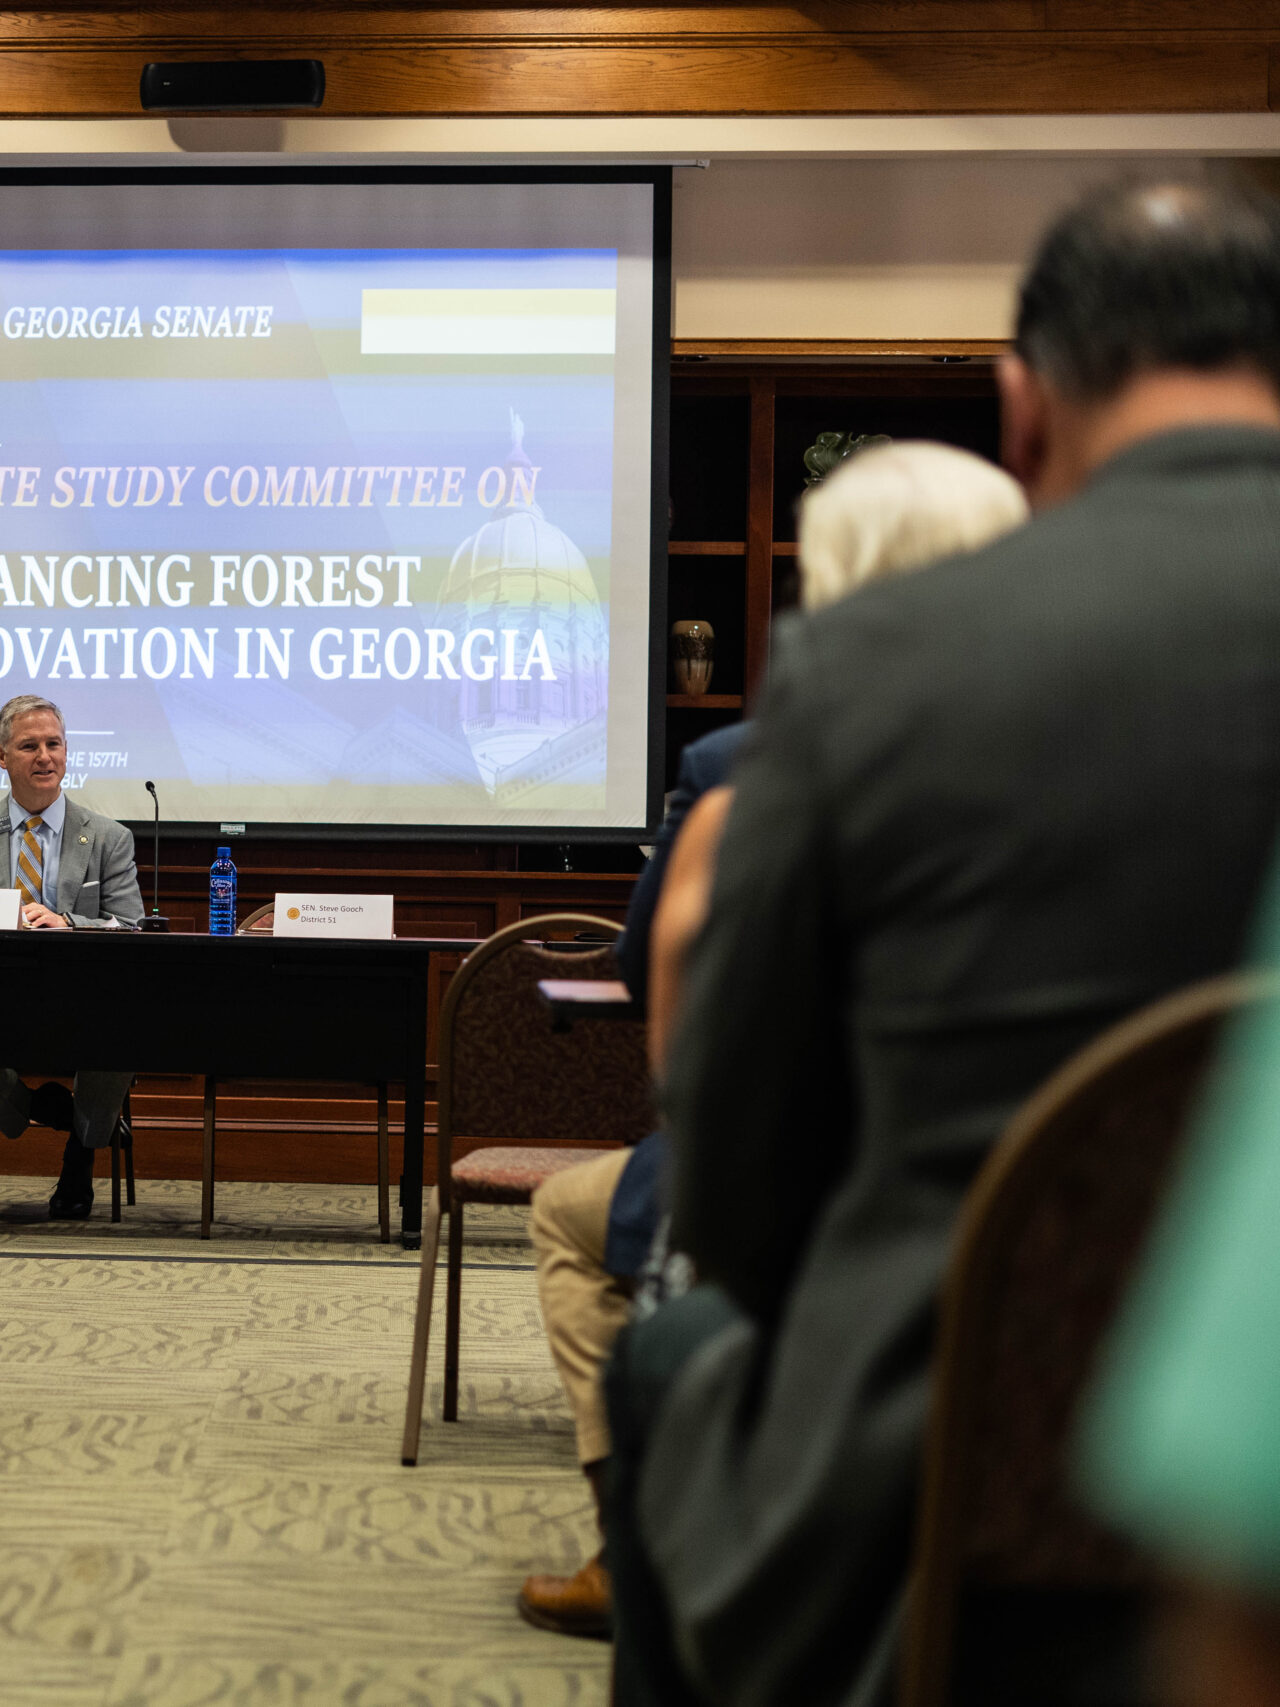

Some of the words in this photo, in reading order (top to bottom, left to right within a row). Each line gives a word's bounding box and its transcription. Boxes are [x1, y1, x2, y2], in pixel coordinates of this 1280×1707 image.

[3, 305, 143, 339] GEORGIA
[151, 305, 274, 338] SENATE
[50, 466, 196, 508] STUDY
[203, 465, 467, 508] COMMITTEE
[476, 466, 542, 508] ON
[209, 554, 422, 608] FOREST
[233, 627, 295, 680] IN
[310, 627, 558, 681] GEORGIA
[65, 751, 85, 767] HE
[88, 751, 128, 768] 157TH
